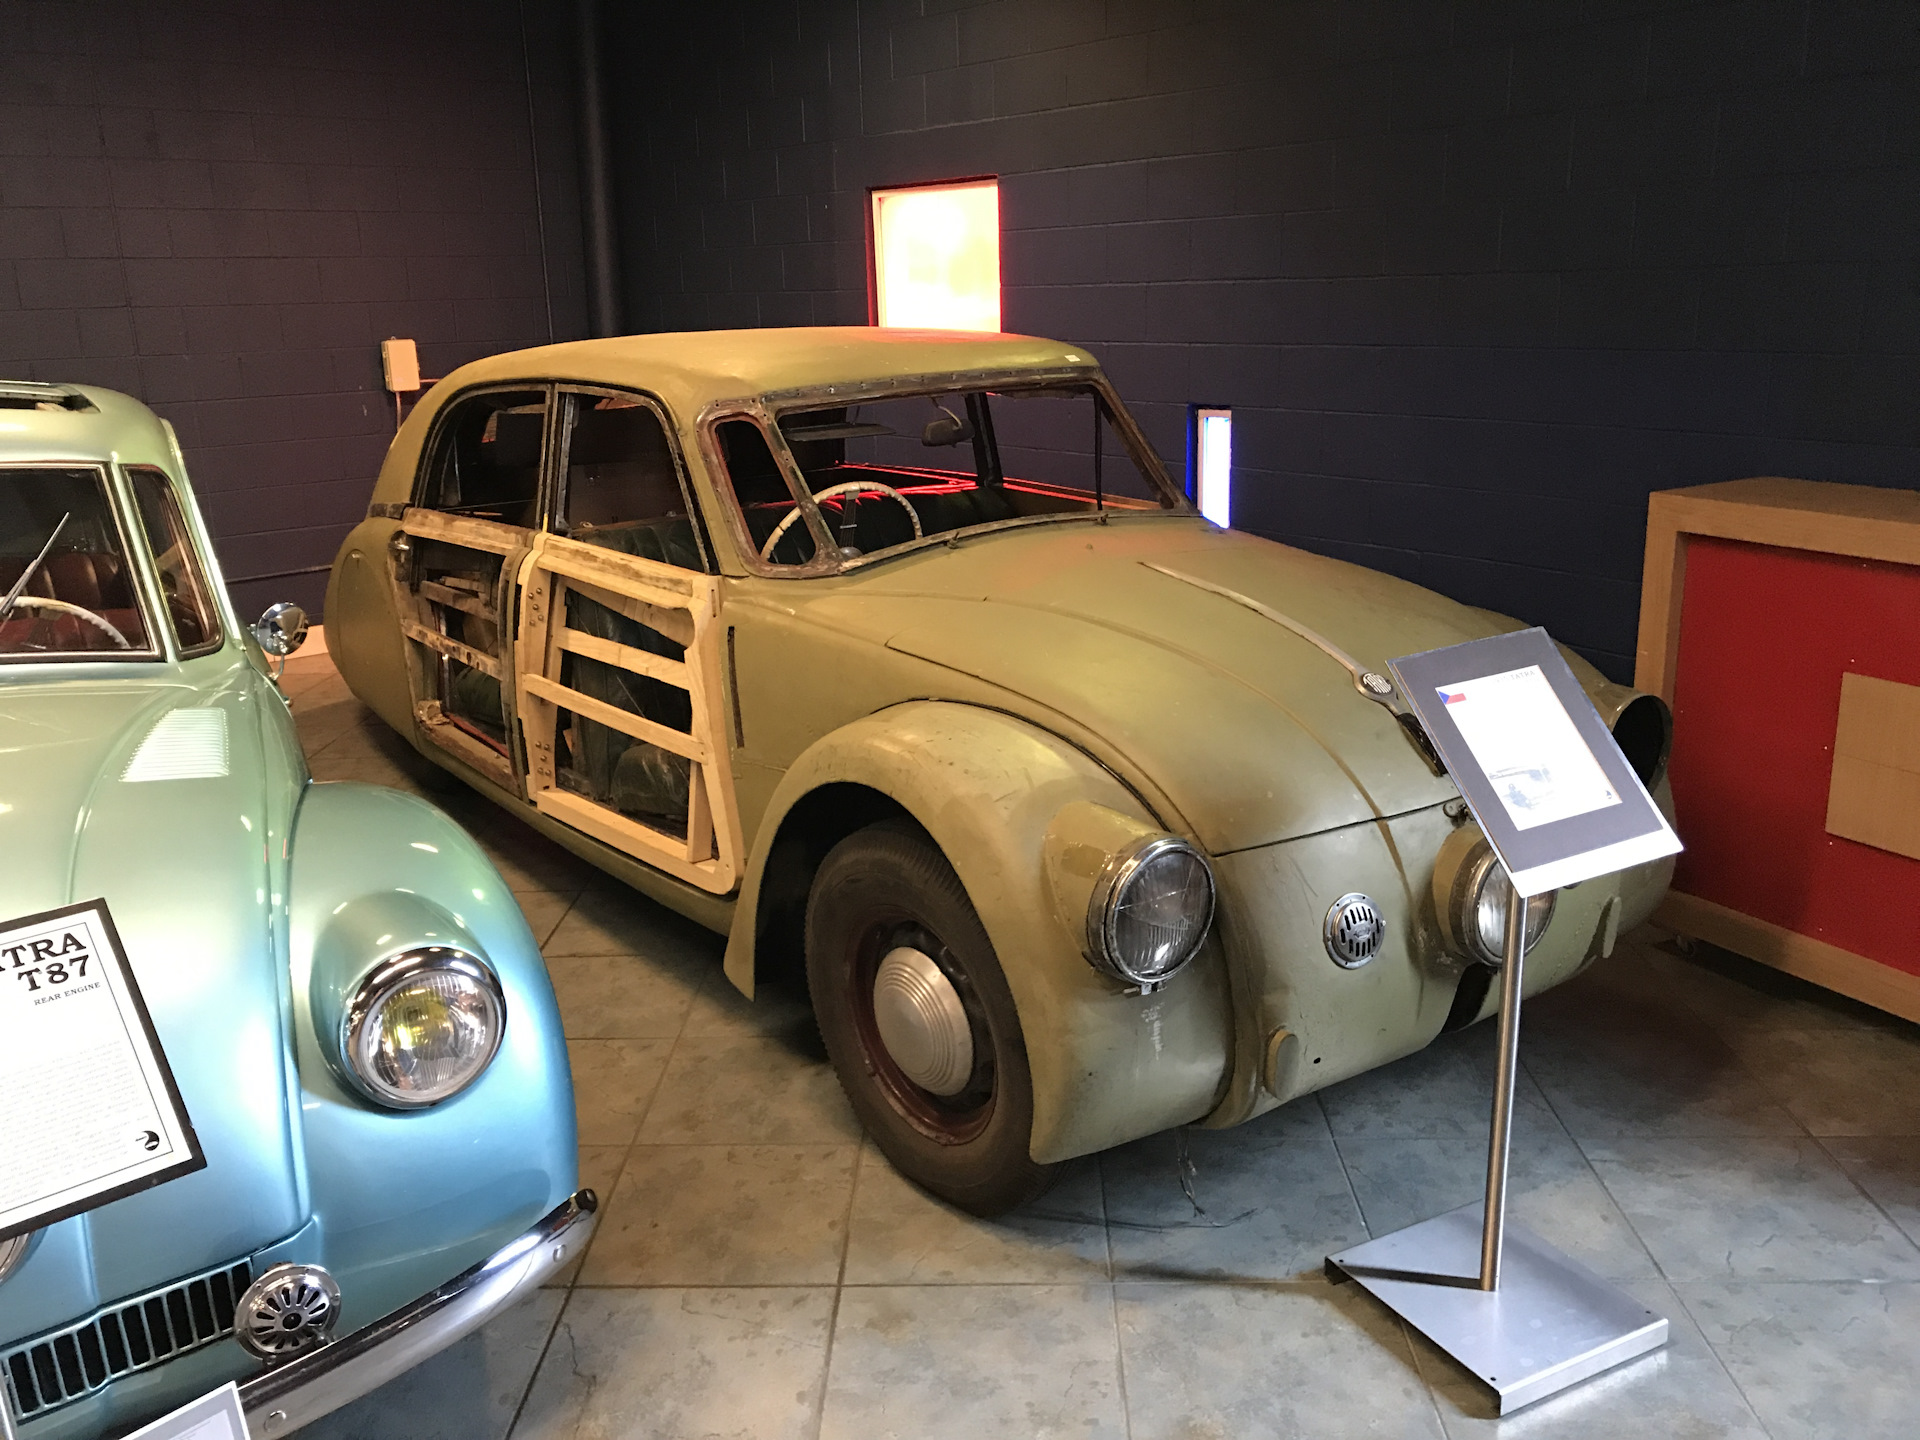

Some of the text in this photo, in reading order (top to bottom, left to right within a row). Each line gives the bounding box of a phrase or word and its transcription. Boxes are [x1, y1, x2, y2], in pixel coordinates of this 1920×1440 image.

[0, 932, 87, 972] TRA
[17, 954, 89, 992] T87
[33, 981, 101, 1006] REAR ENGINE
